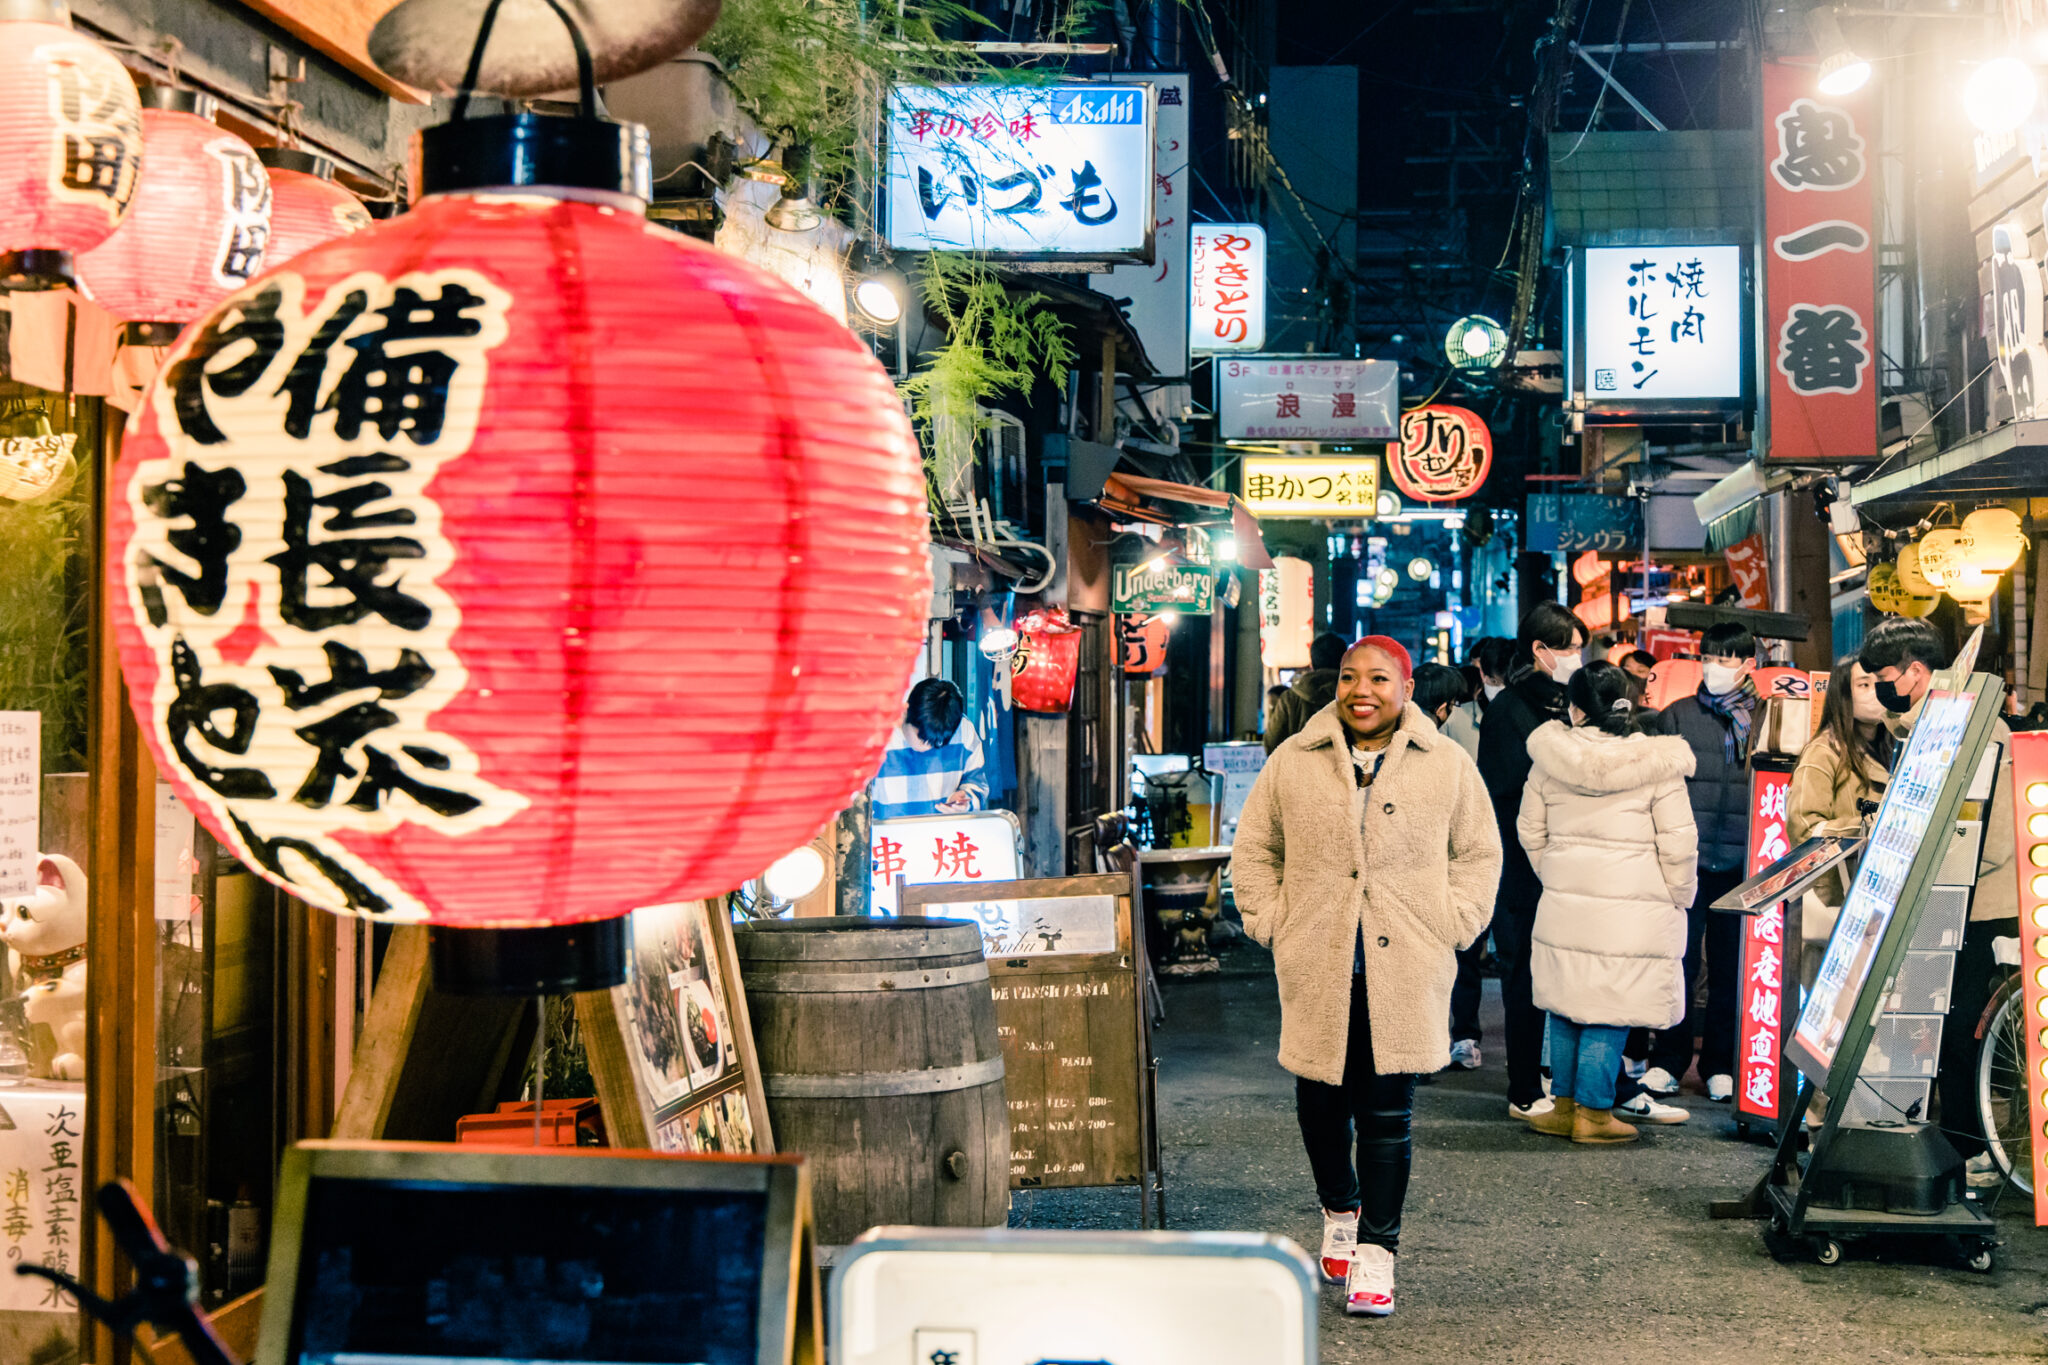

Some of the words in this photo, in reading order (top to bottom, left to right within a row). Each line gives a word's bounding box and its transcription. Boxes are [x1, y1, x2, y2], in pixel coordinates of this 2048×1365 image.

[909, 110, 1041, 143] 串の珍味
[1060, 93, 1134, 124] Asahi
[917, 160, 1118, 227] いづも
[1213, 233, 1251, 343] やきとり
[1627, 258, 1659, 389] ホルモン
[1665, 257, 1710, 344] 焼肉
[1228, 362, 1251, 378] 3F
[1248, 473, 1333, 501] 串かつ
[264, 283, 487, 818] 備長炭
[1116, 568, 1211, 602] Underberg
[872, 831, 982, 887] 串焼
[1745, 782, 1789, 1108] 明石港産地直送
[2, 1168, 33, 1262] 消毒の
[40, 1104, 80, 1309] 次亜塩素酸水
